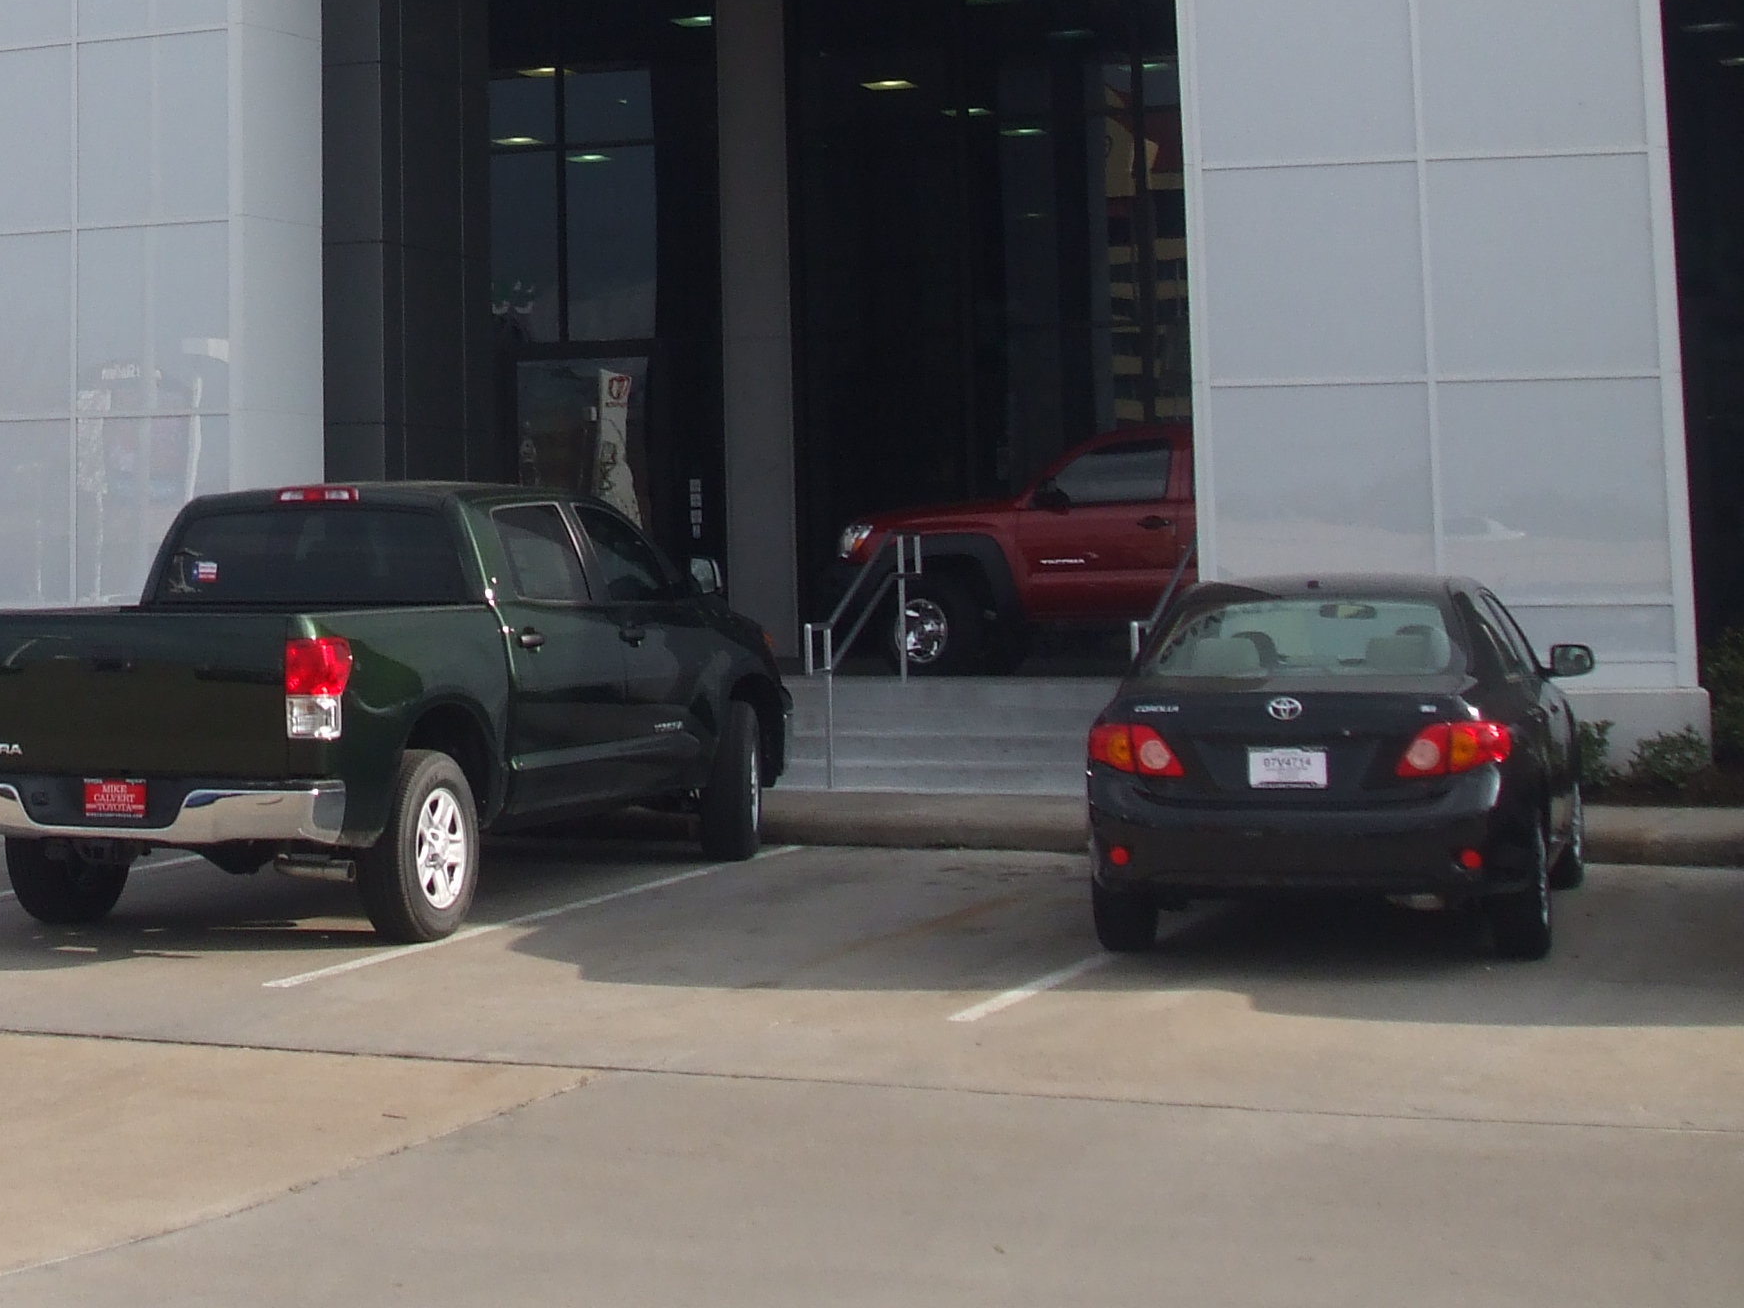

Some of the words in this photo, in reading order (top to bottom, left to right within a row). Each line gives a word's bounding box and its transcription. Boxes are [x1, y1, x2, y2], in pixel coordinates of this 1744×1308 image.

[101, 784, 128, 794] MIKE
[93, 793, 136, 803] CALVERT
[96, 803, 133, 812] TOYOTA
